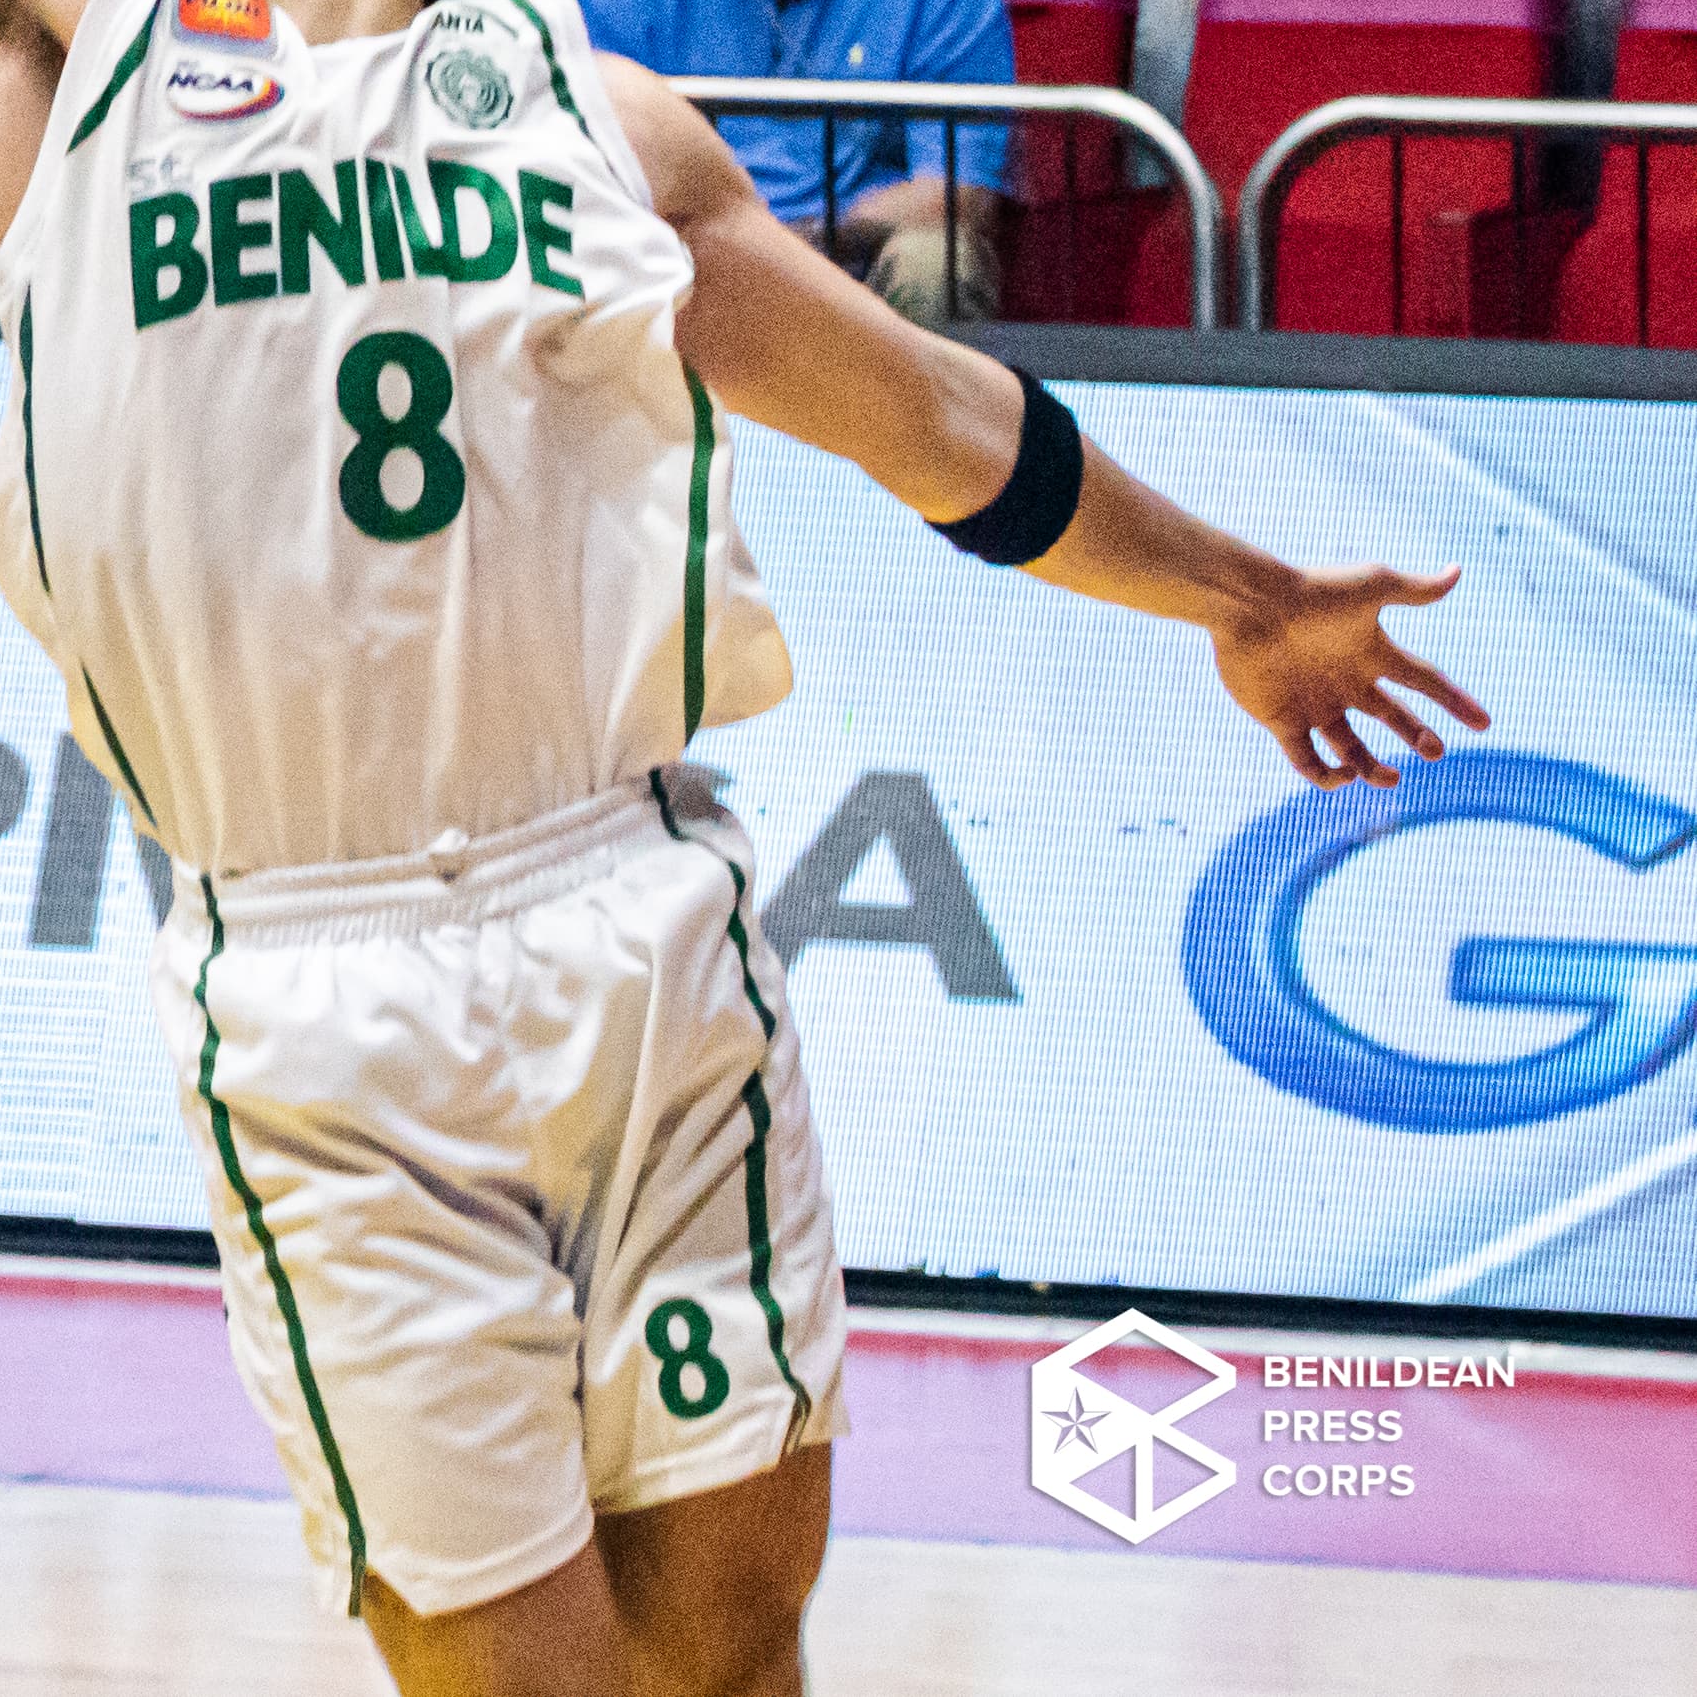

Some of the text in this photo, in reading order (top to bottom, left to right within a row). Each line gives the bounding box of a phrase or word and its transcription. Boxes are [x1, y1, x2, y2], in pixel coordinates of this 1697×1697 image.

[166, 71, 255, 93] NCAA
[127, 153, 587, 332] BENILDE
[336, 330, 467, 544] 8
[645, 1297, 731, 1420] 8
